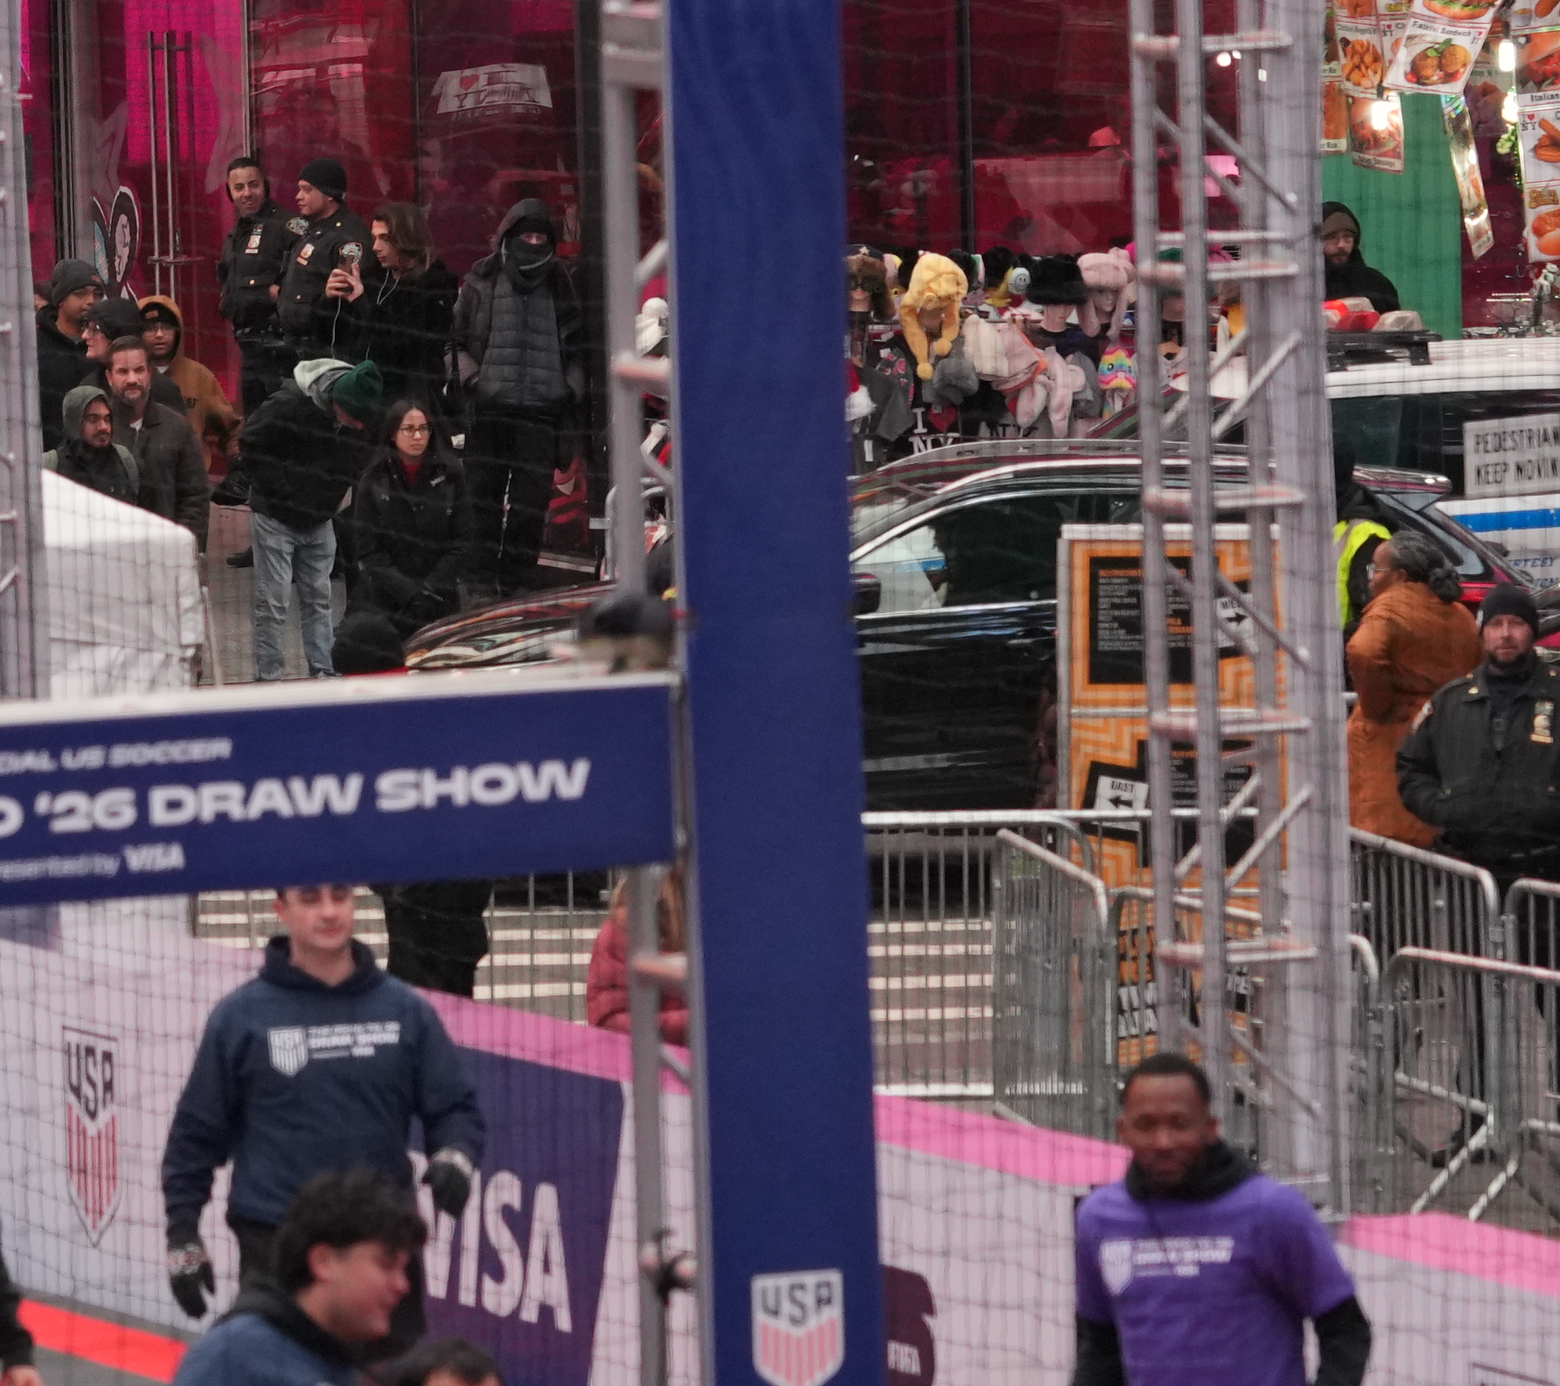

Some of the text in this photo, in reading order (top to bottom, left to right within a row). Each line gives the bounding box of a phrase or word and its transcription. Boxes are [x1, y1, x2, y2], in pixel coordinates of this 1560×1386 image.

[1473, 425, 1560, 454] PEDESTRIAN
[1474, 461, 1509, 486] KEEP
[64, 749, 106, 769] US
[109, 737, 233, 767] SOCCER
[35, 788, 134, 835] '26
[148, 773, 364, 829] DRAW
[373, 758, 591, 811] SHOW
[123, 844, 186, 875] VISA
[66, 1040, 117, 1121] USA
[760, 1280, 836, 1327] USA
